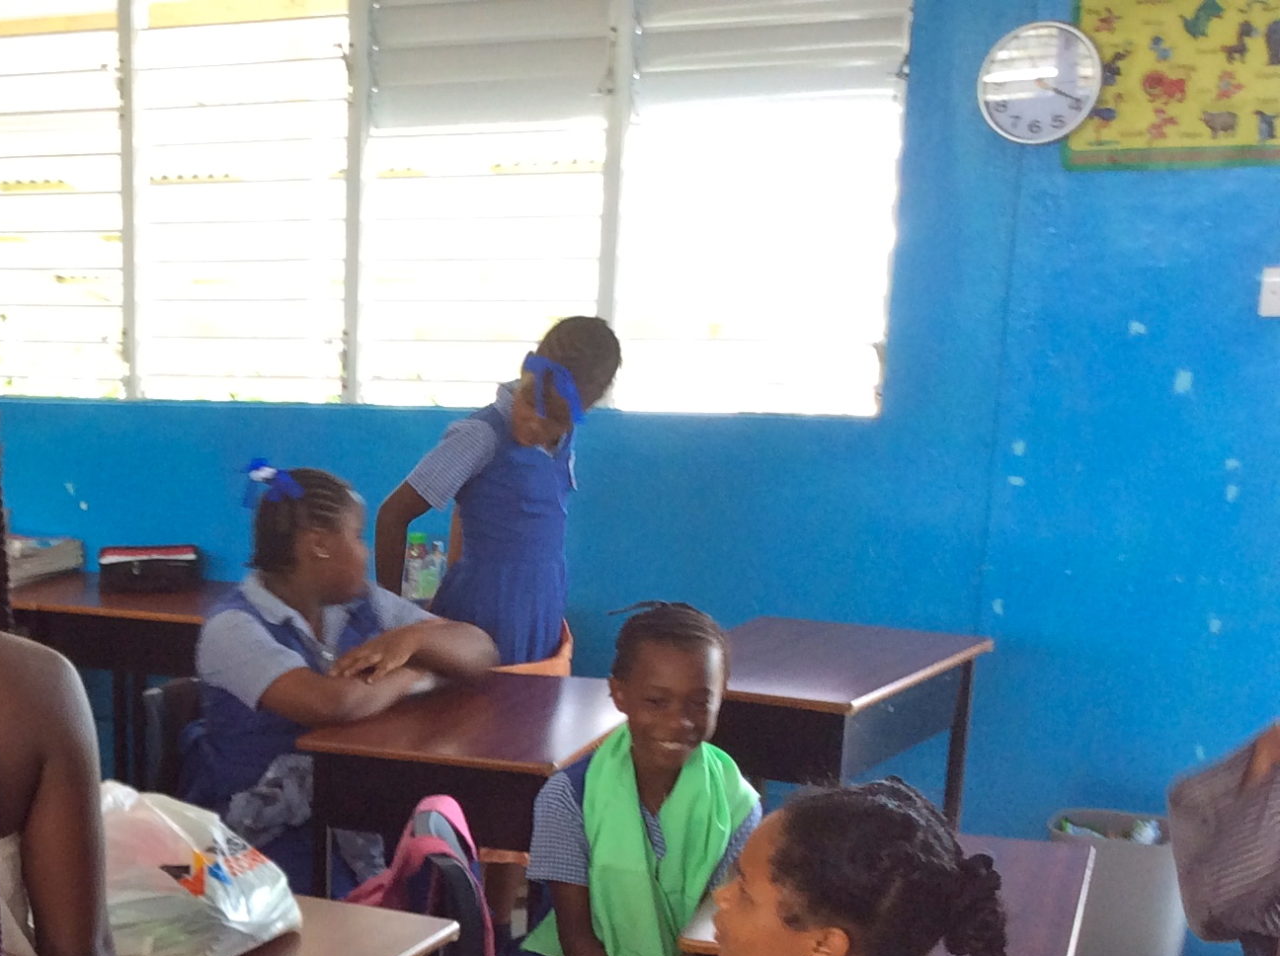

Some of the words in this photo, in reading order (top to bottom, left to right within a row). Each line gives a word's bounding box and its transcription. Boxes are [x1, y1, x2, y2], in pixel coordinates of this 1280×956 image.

[1010, 114, 1021, 129] 7
[1027, 120, 1041, 134] 6
[1050, 114, 1065, 129] 5
